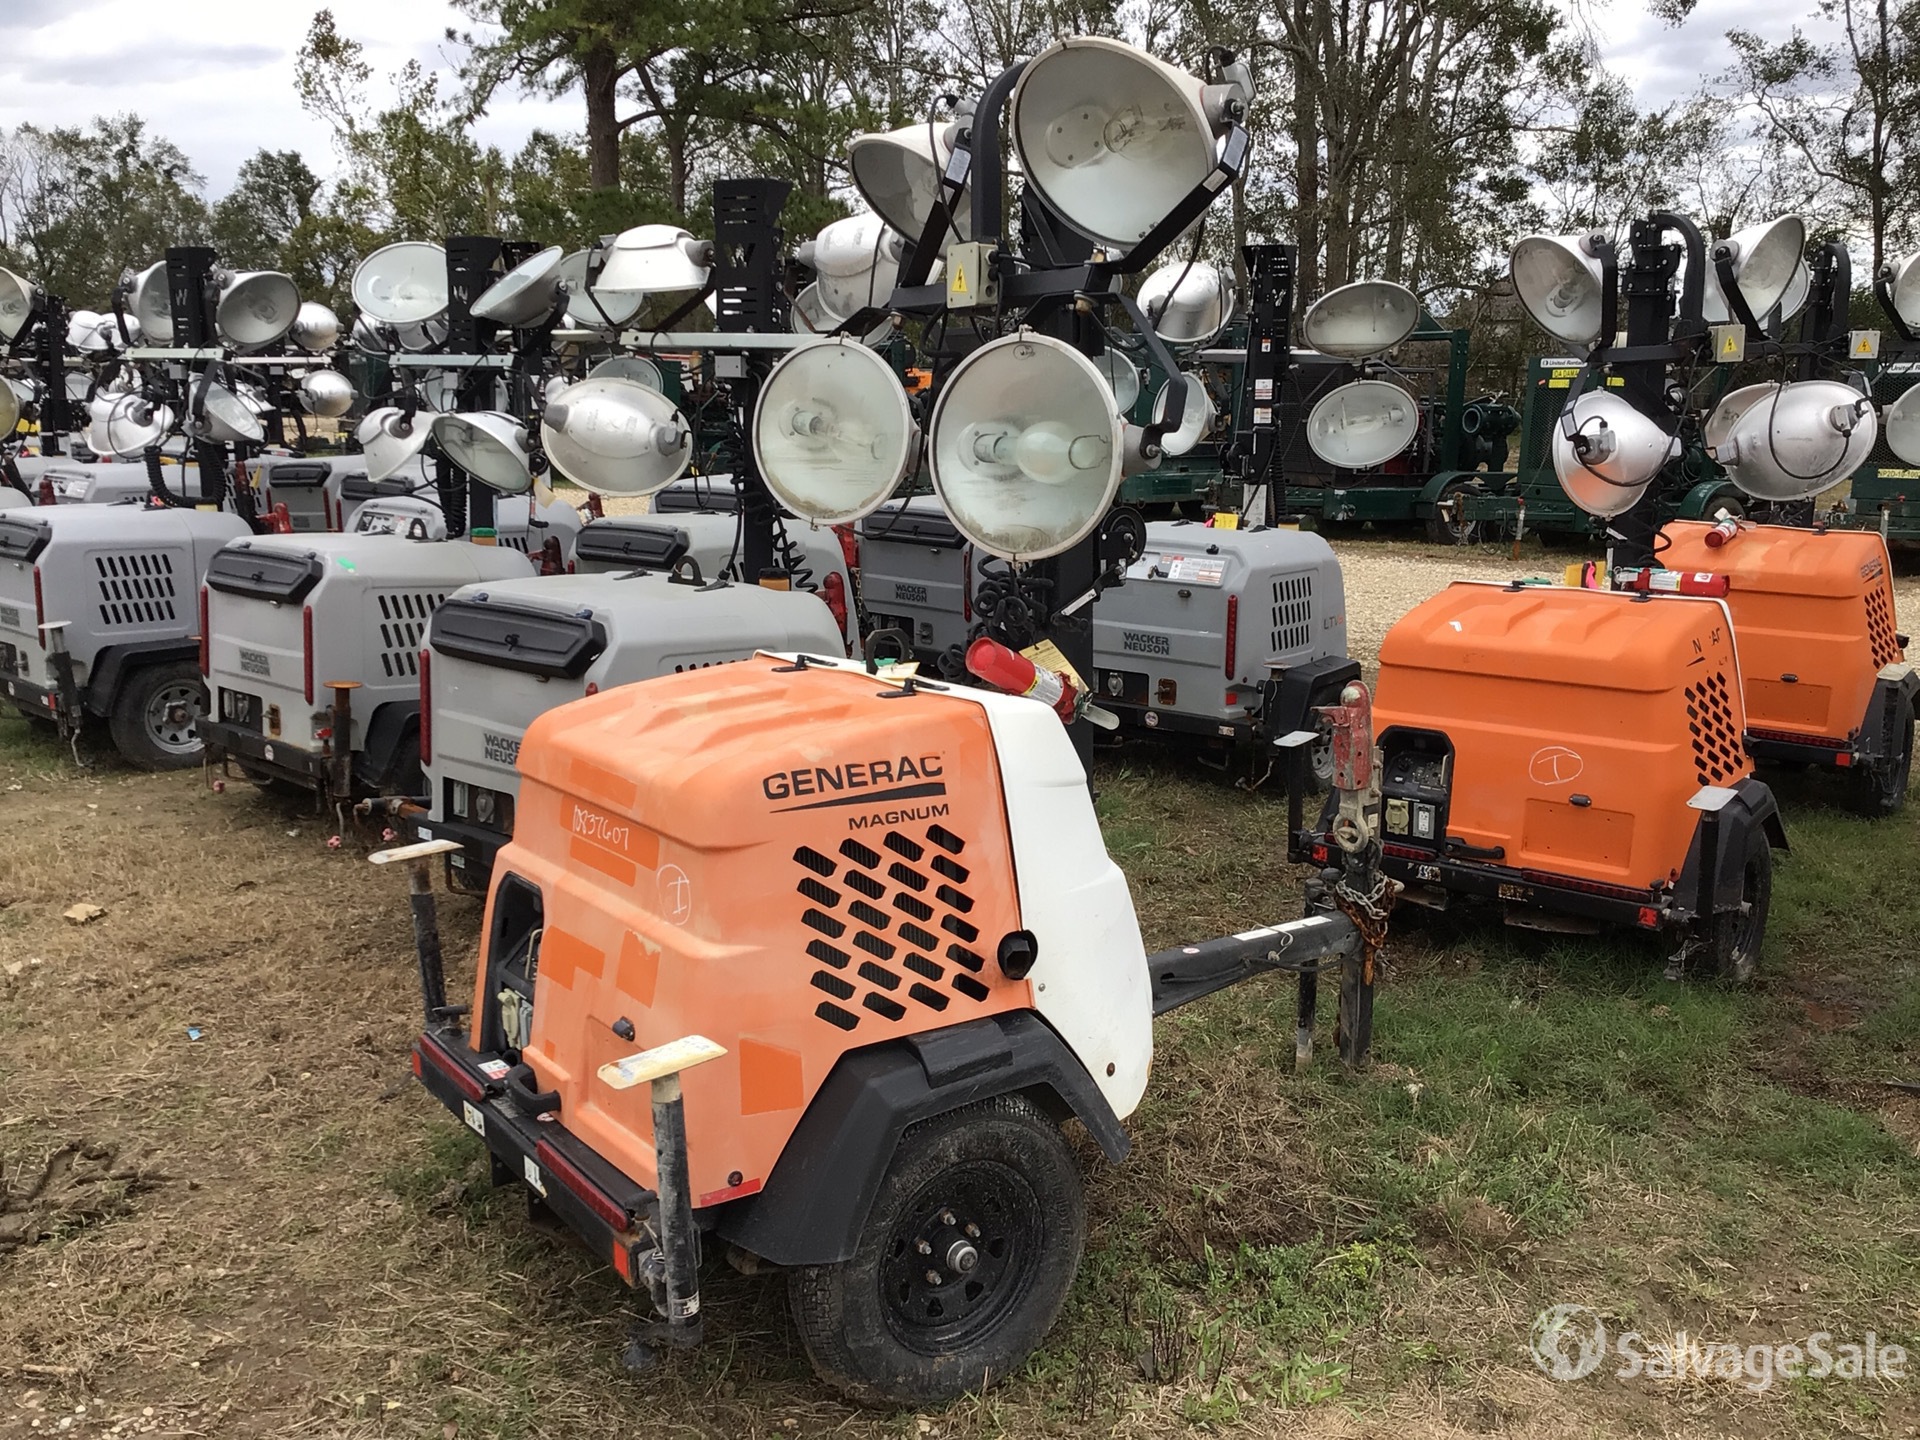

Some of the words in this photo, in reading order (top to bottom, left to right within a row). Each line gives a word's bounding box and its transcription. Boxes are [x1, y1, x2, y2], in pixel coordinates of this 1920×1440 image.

[895, 583, 927, 594] WACKER
[895, 592, 927, 602] NEUSON
[1123, 631, 1170, 646] WACKER
[1123, 641, 1170, 656] NEUSON
[484, 733, 521, 754] WACKE
[484, 747, 519, 766] NEUS
[762, 755, 944, 800] GENERAC
[848, 804, 950, 831] MAGNUM
